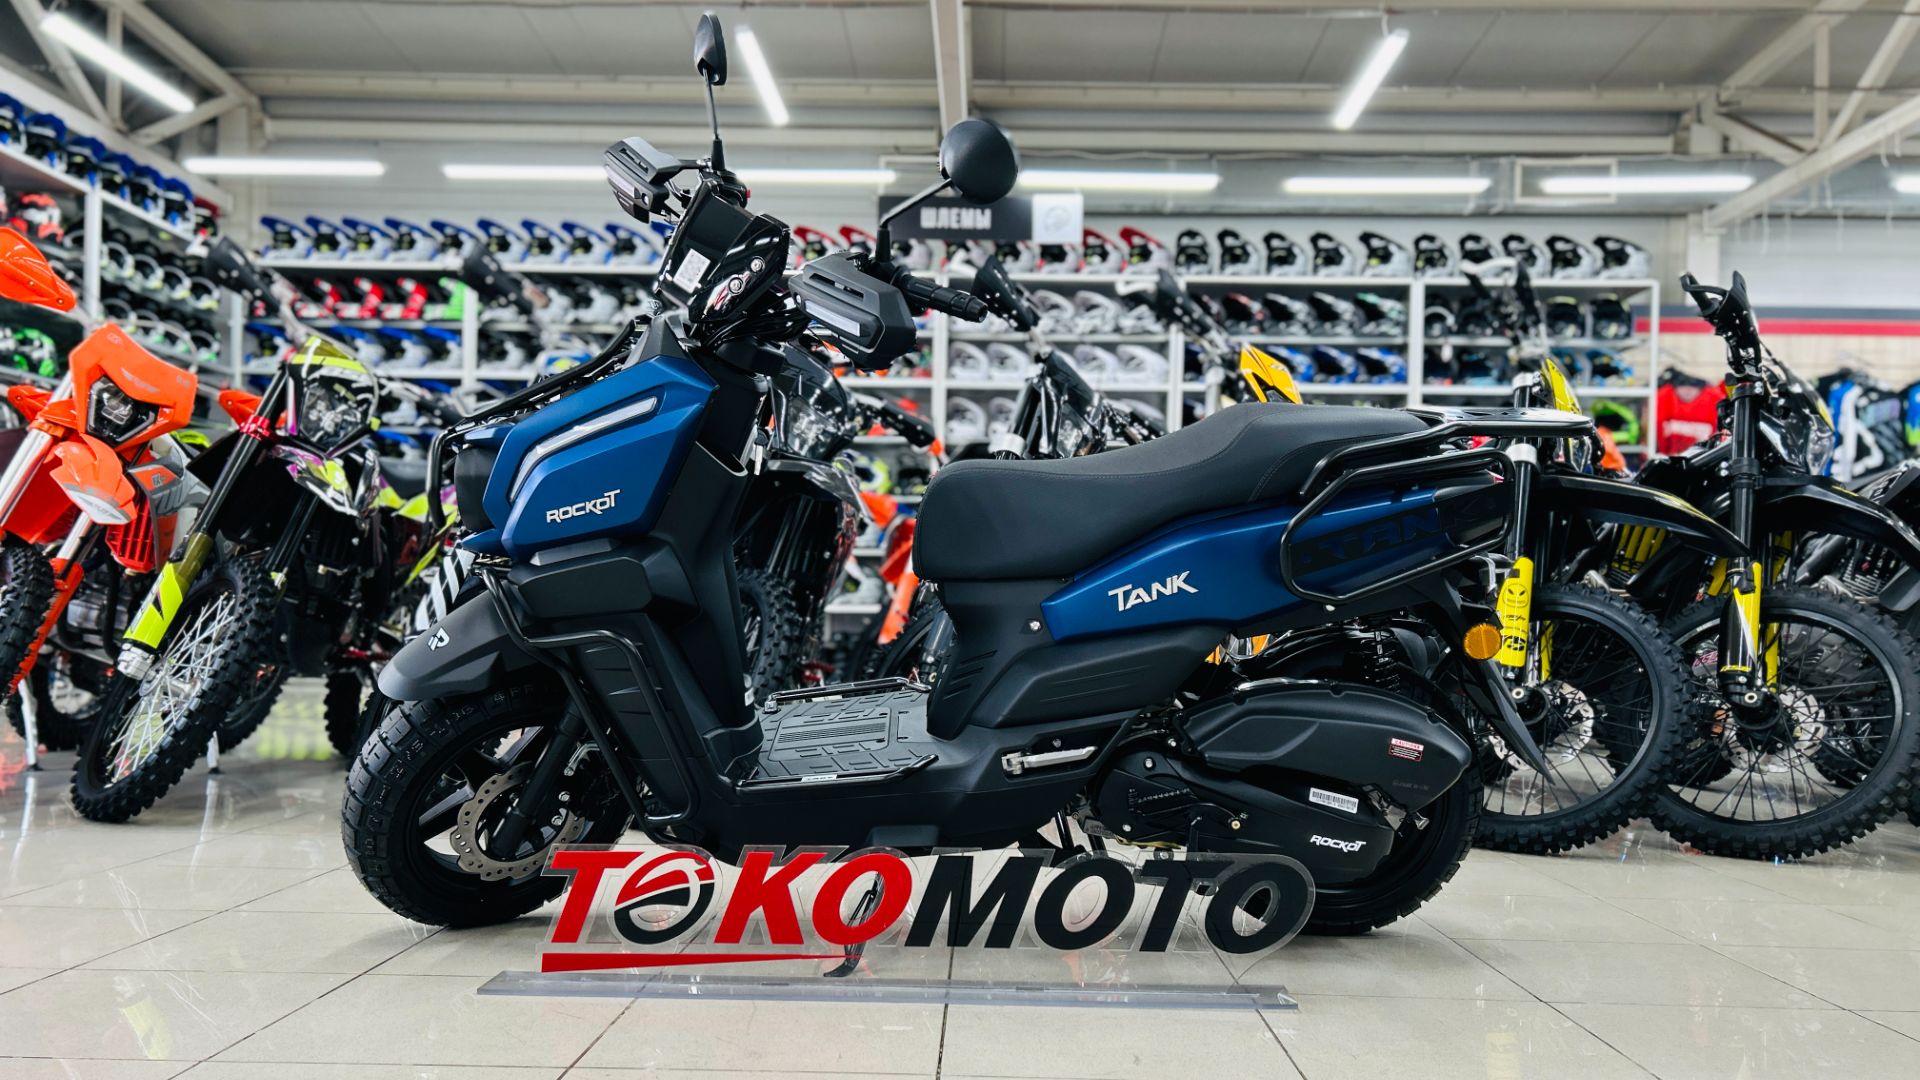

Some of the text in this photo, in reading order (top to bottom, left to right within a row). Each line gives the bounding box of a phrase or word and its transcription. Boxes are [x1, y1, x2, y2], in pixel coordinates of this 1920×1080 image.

[919, 206, 992, 230] ШЛЕМЫ
[546, 488, 621, 523] ROCKOT
[1108, 570, 1199, 612] TANK
[1309, 834, 1367, 853] ROCKOT
[550, 850, 1310, 955] TOKOMOTO
